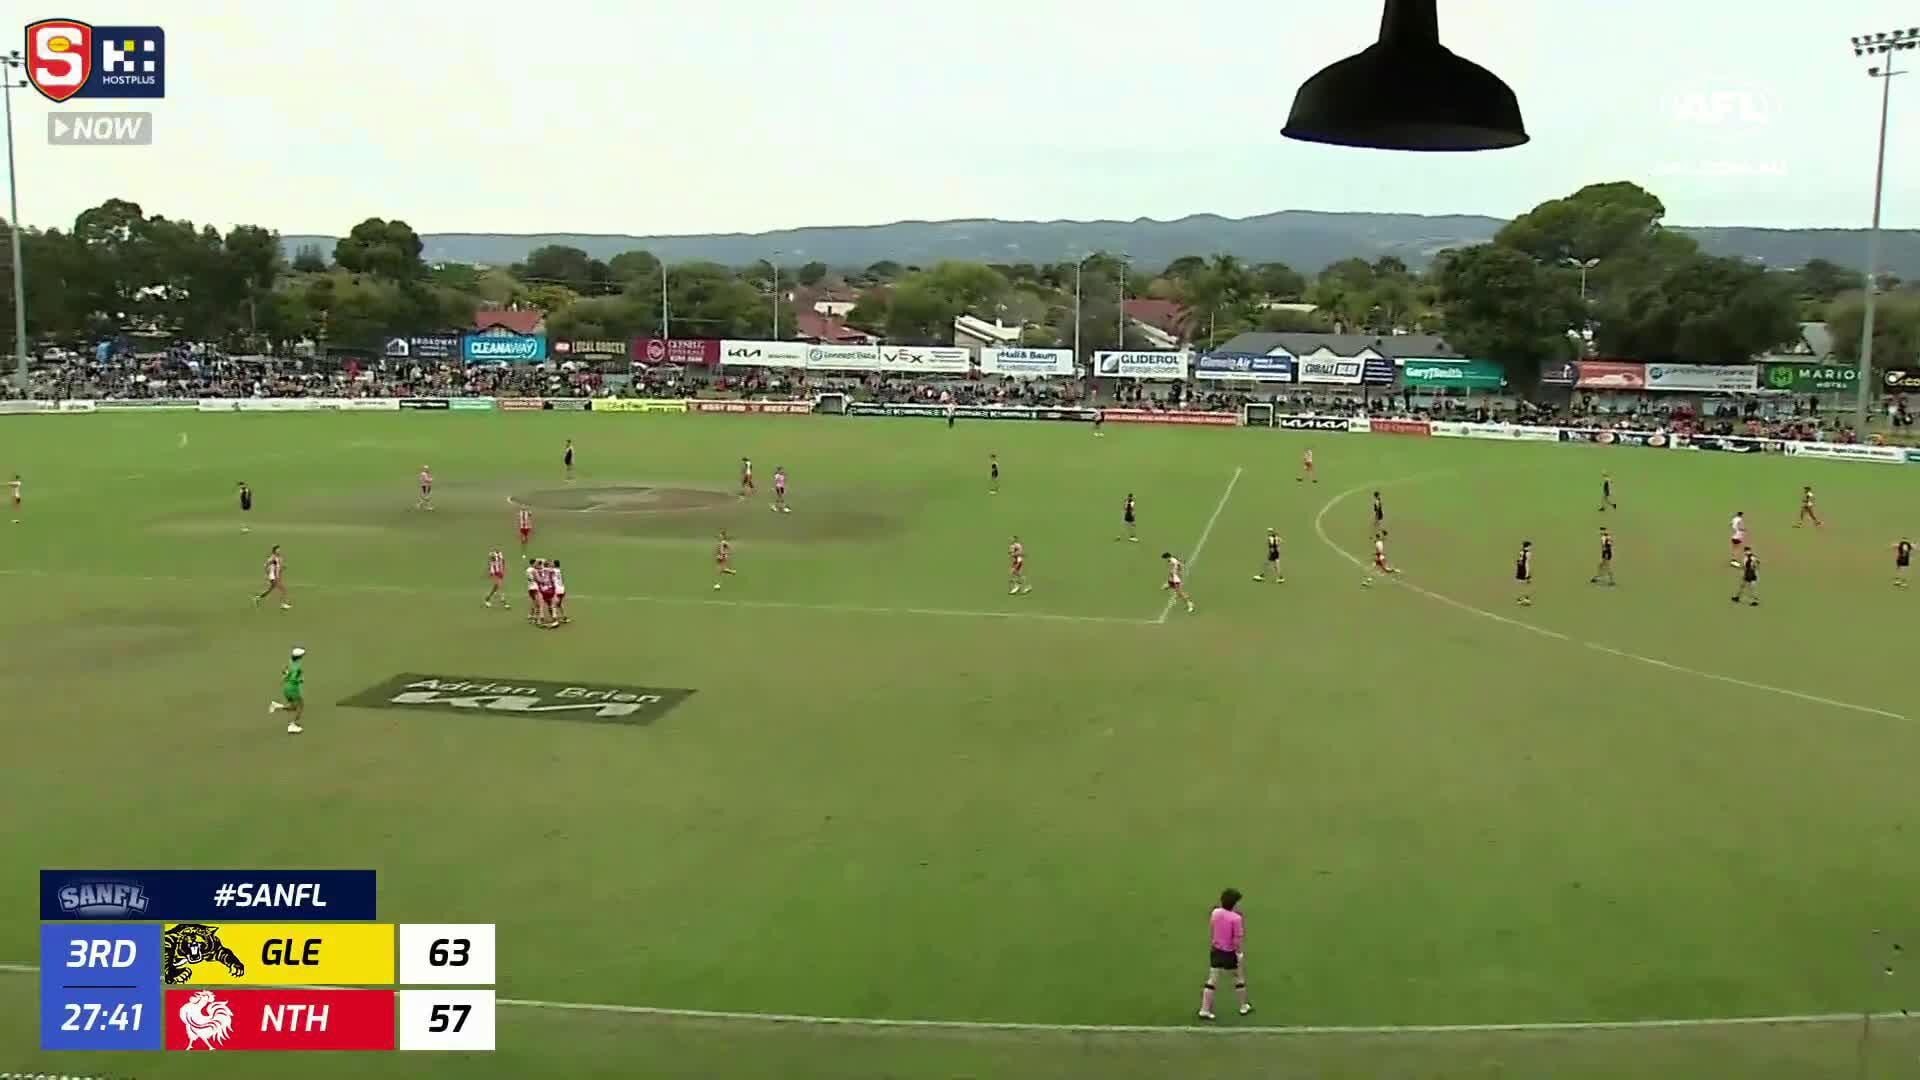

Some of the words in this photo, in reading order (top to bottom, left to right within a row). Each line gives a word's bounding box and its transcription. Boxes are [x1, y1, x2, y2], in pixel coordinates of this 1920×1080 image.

[471, 340, 534, 355] CLEANAWAY
[1121, 354, 1179, 365] GLIDEROL
[405, 679, 537, 696] Adrian
